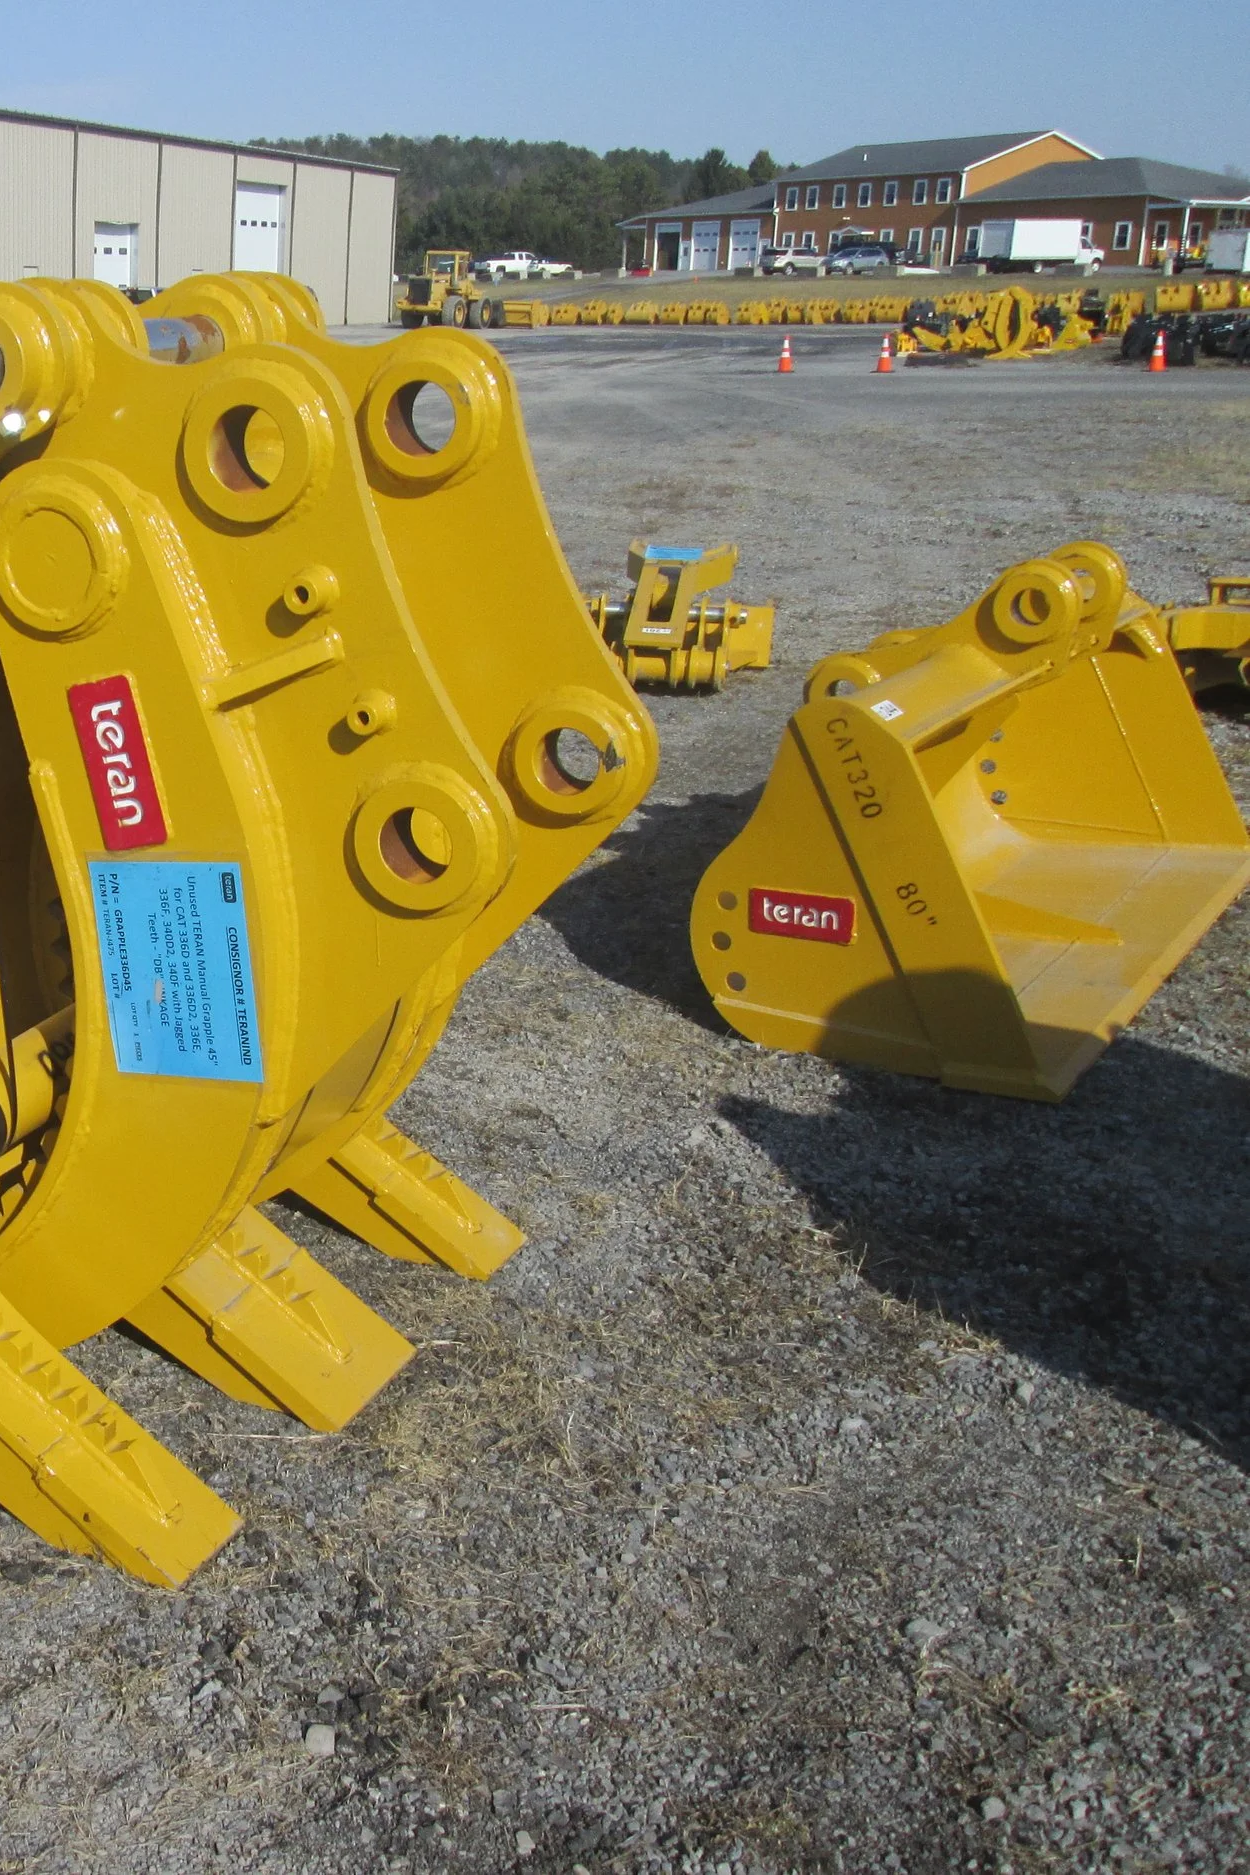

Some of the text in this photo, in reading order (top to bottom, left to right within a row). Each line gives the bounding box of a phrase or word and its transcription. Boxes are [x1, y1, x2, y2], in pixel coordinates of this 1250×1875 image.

[90, 700, 144, 827] teran
[826, 718, 937, 926] CAT320 80"
[98, 873, 108, 898] ITEM
[109, 873, 120, 894] P/N
[224, 875, 234, 900] teran
[147, 912, 160, 944] Teeth
[763, 897, 839, 931] teran
[114, 909, 133, 992] GRAPPLE336D45
[153, 953, 165, 979] "DB"
[158, 888, 188, 1052] 336F, 340D2, 340F with Jagged
[173, 887, 202, 1054] for CAT 336D and 336D2, 336E,
[186, 876, 219, 1066] Unused TERAN Manual Grapple 45"
[111, 972, 120, 992] LOT
[228, 926, 244, 996] CONSIGNOR
[237, 1008, 252, 1066] TERANIND
